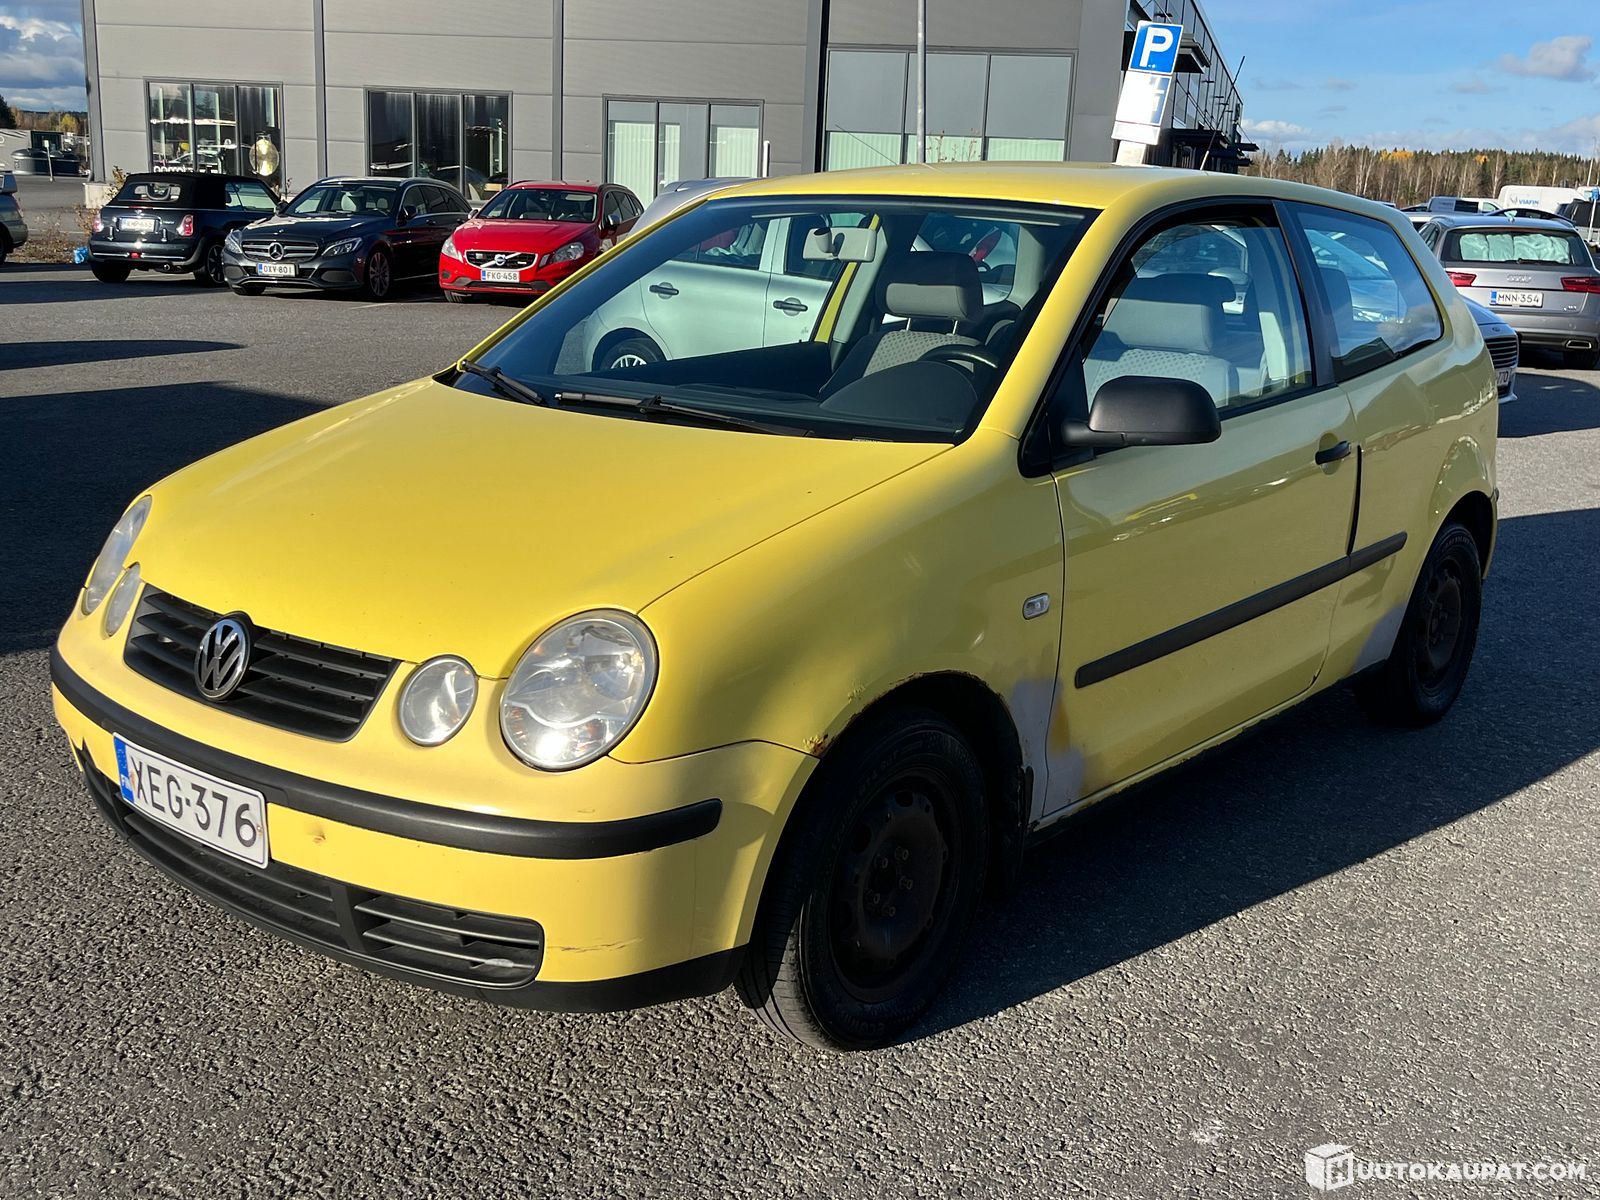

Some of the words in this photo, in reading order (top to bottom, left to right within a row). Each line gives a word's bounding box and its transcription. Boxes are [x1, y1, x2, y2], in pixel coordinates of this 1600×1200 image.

[1139, 26, 1174, 68] P
[486, 271, 518, 281] FKG-458
[1497, 293, 1540, 303] MNN-354
[130, 755, 257, 848] XEG-376
